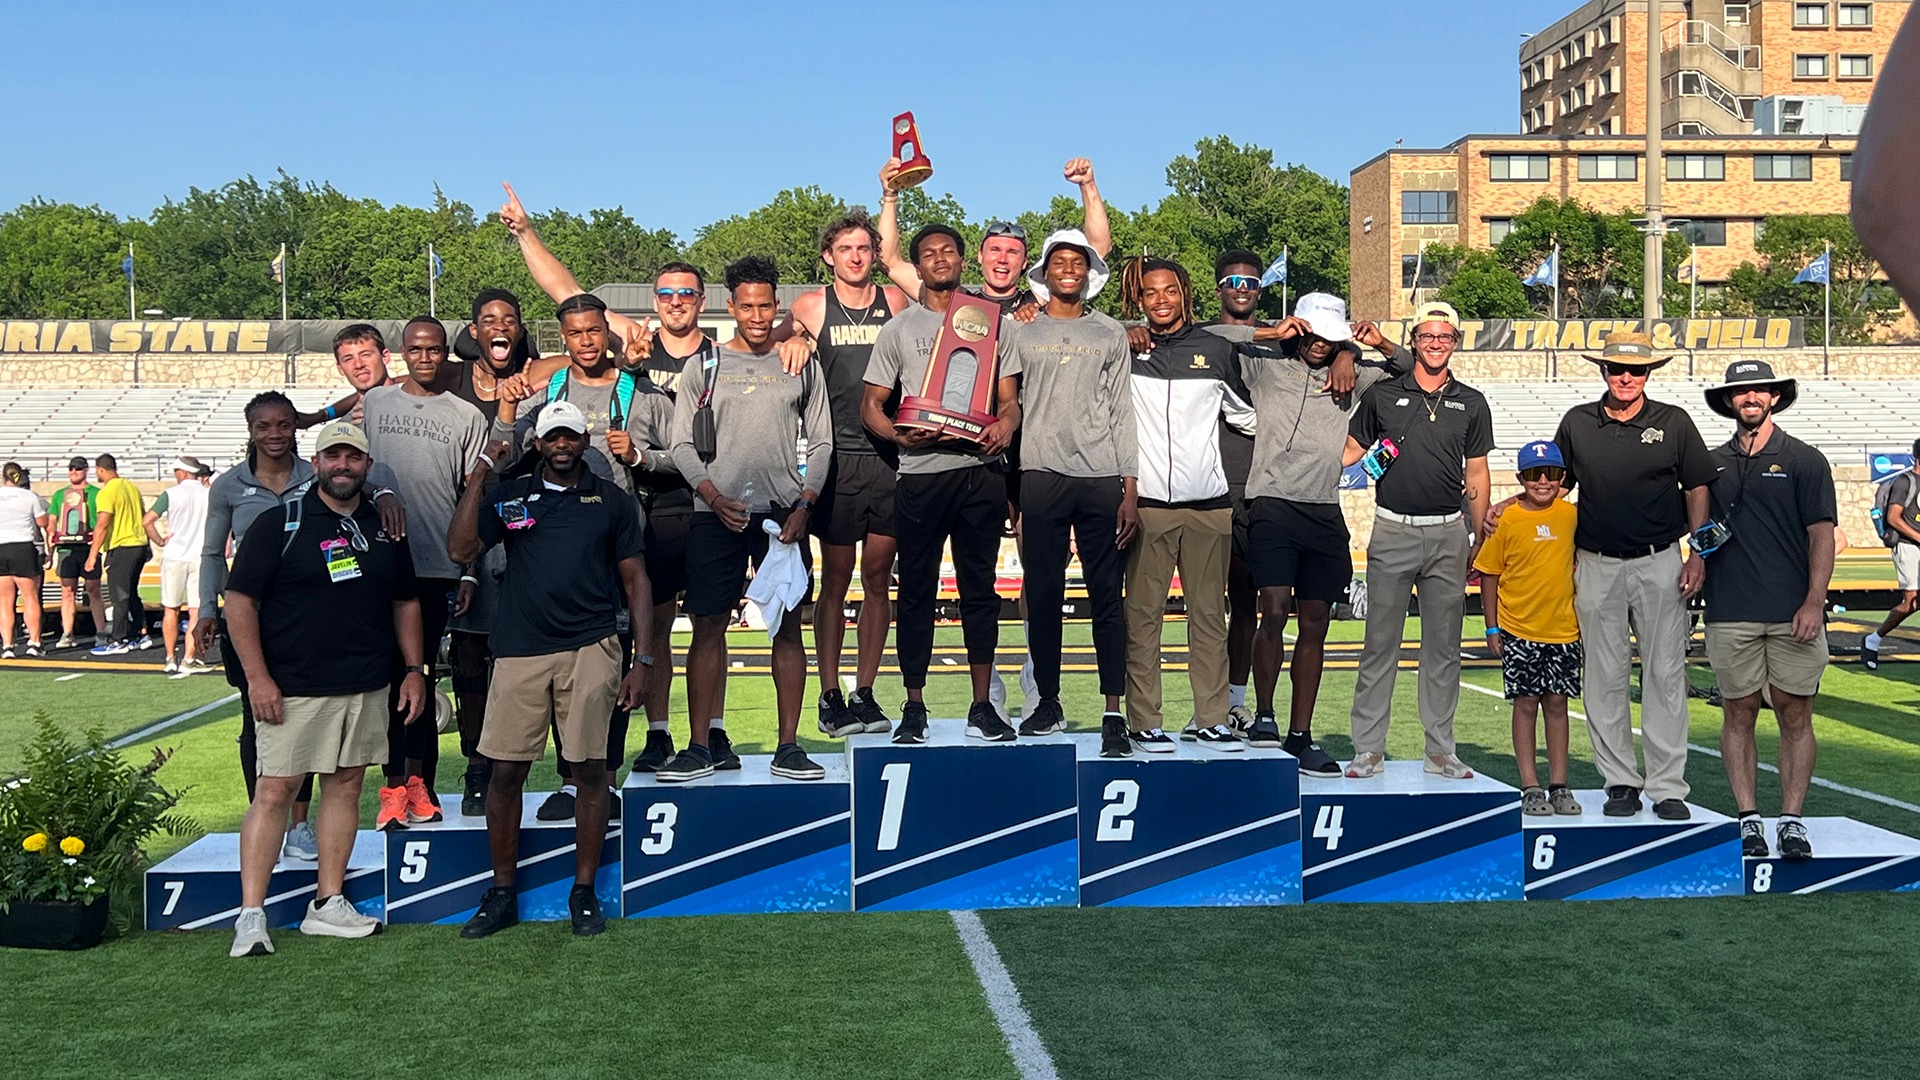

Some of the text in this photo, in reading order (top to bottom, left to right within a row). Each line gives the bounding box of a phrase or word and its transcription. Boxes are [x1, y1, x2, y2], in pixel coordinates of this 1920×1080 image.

[0, 322, 271, 352] RIA STATE
[954, 318, 990, 337] NCAA
[1652, 322, 1678, 350] &
[1684, 318, 1792, 349] FIELD
[377, 425, 451, 445] TRACK & FIELD
[378, 414, 453, 437] HARDING
[946, 417, 966, 429] PLACE
[965, 422, 982, 434] TEAM
[1532, 443, 1548, 458] T
[877, 763, 911, 851] 1
[1096, 779, 1140, 842] 2
[640, 802, 679, 856] 3
[1312, 805, 1344, 850] 4
[400, 841, 430, 883] 5
[1532, 833, 1557, 871] 6
[1752, 862, 1773, 893] 8
[162, 881, 184, 916] 7
